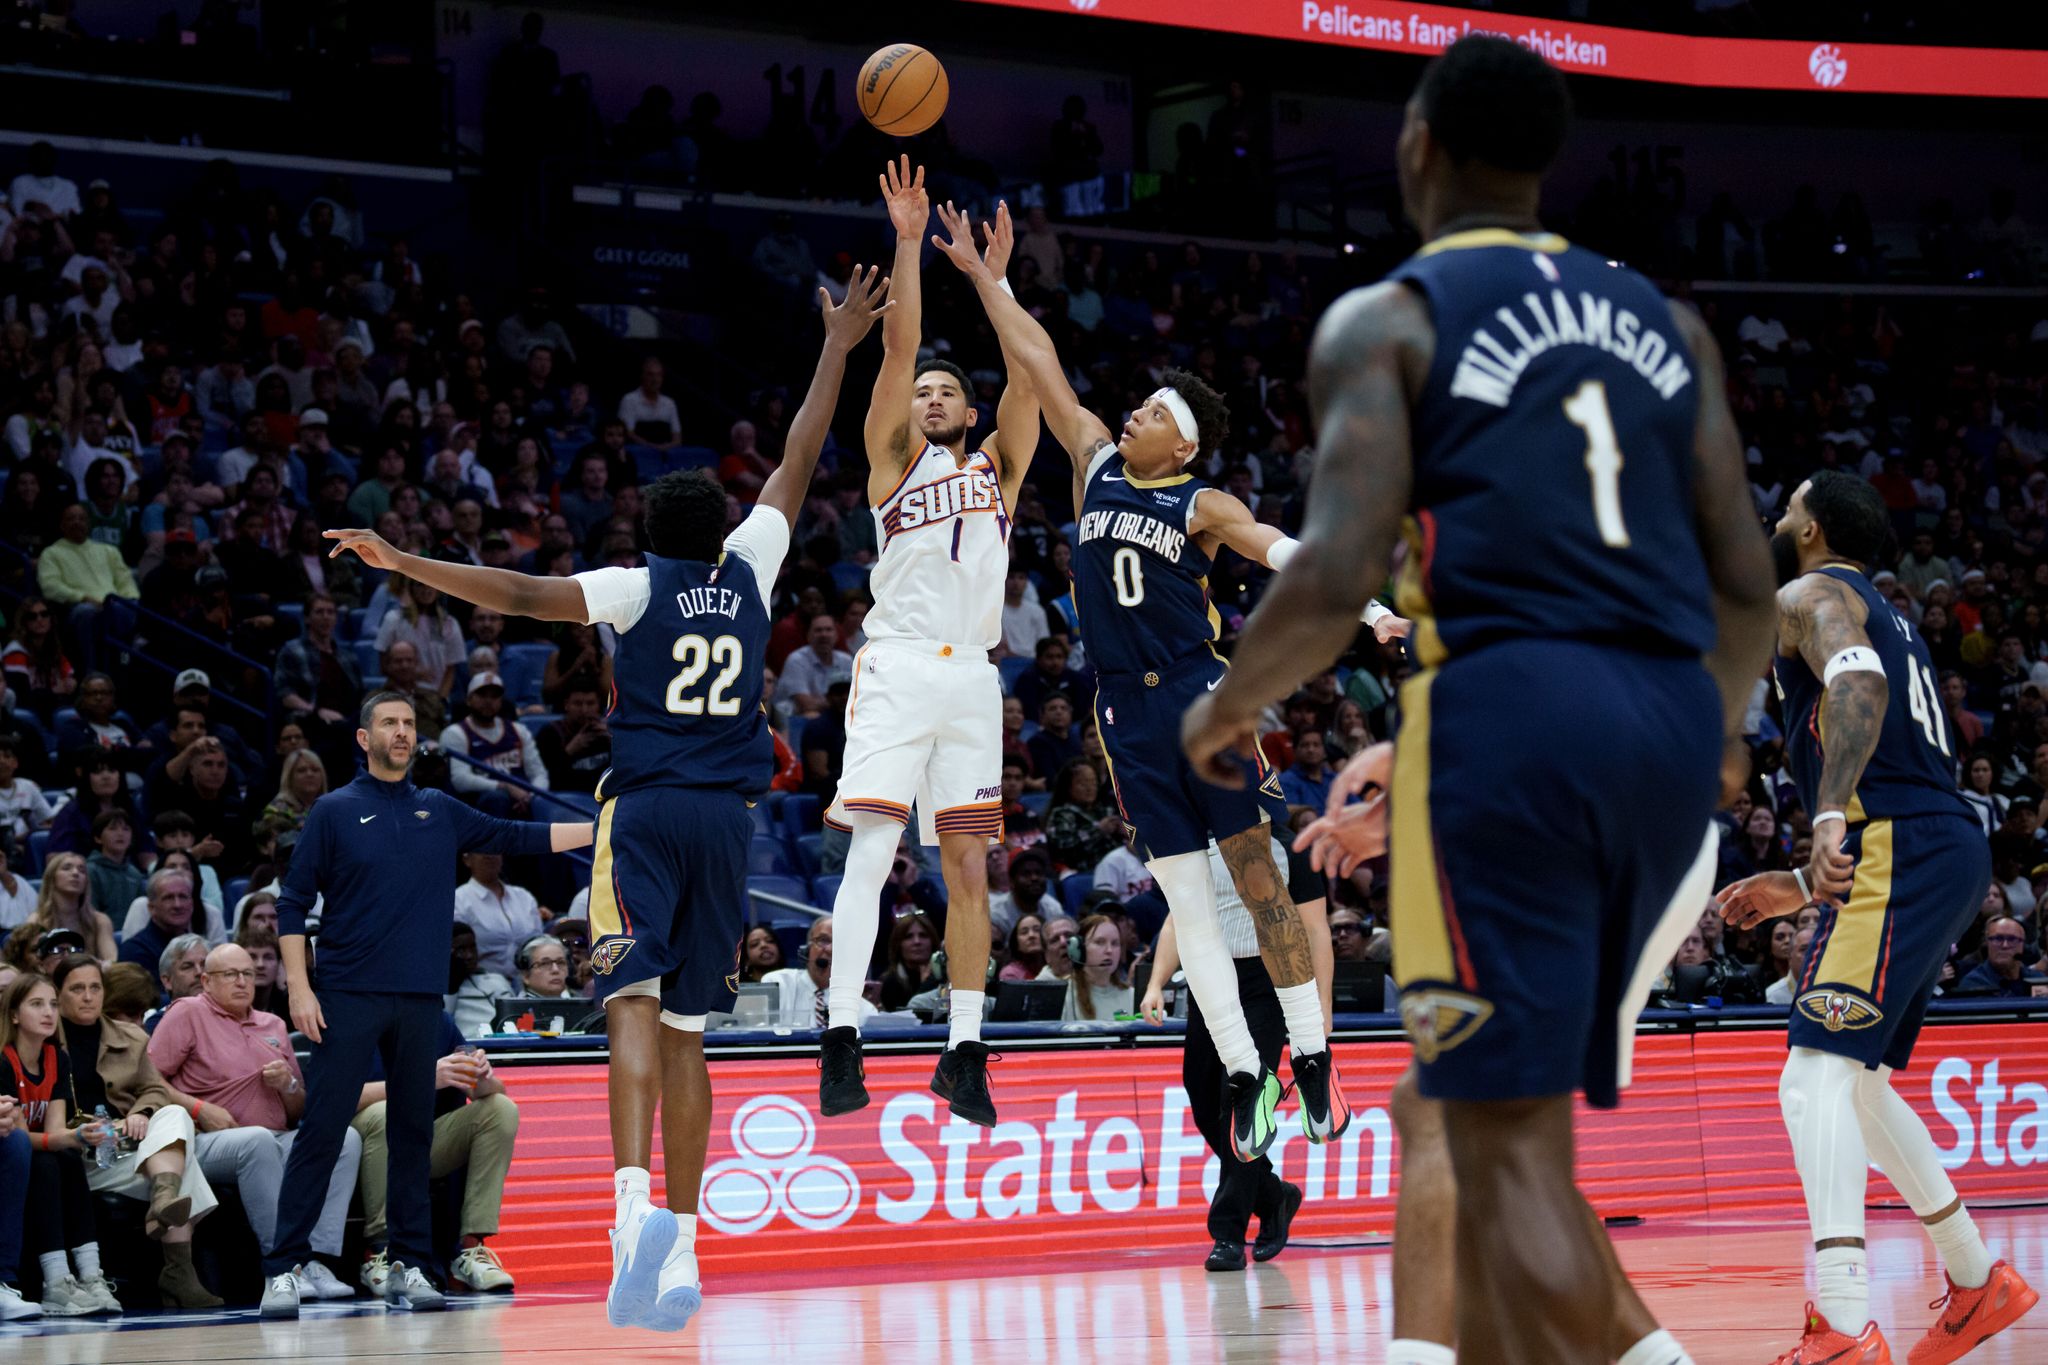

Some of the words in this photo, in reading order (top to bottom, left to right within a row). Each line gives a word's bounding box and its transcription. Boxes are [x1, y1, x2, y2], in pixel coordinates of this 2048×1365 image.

[1302, 1, 1403, 43] Pelicans
[1409, 14, 1457, 47] fans
[1449, 288, 1692, 408] WILLIAMSON
[1561, 379, 1632, 549] 1
[951, 517, 964, 564] 1
[1078, 510, 1116, 547] NEW
[1110, 511, 1186, 564] ORLEANS
[676, 587, 742, 621] QUEEN
[1112, 547, 1146, 608] 0
[665, 633, 743, 717] 22
[1907, 653, 1952, 758] 41
